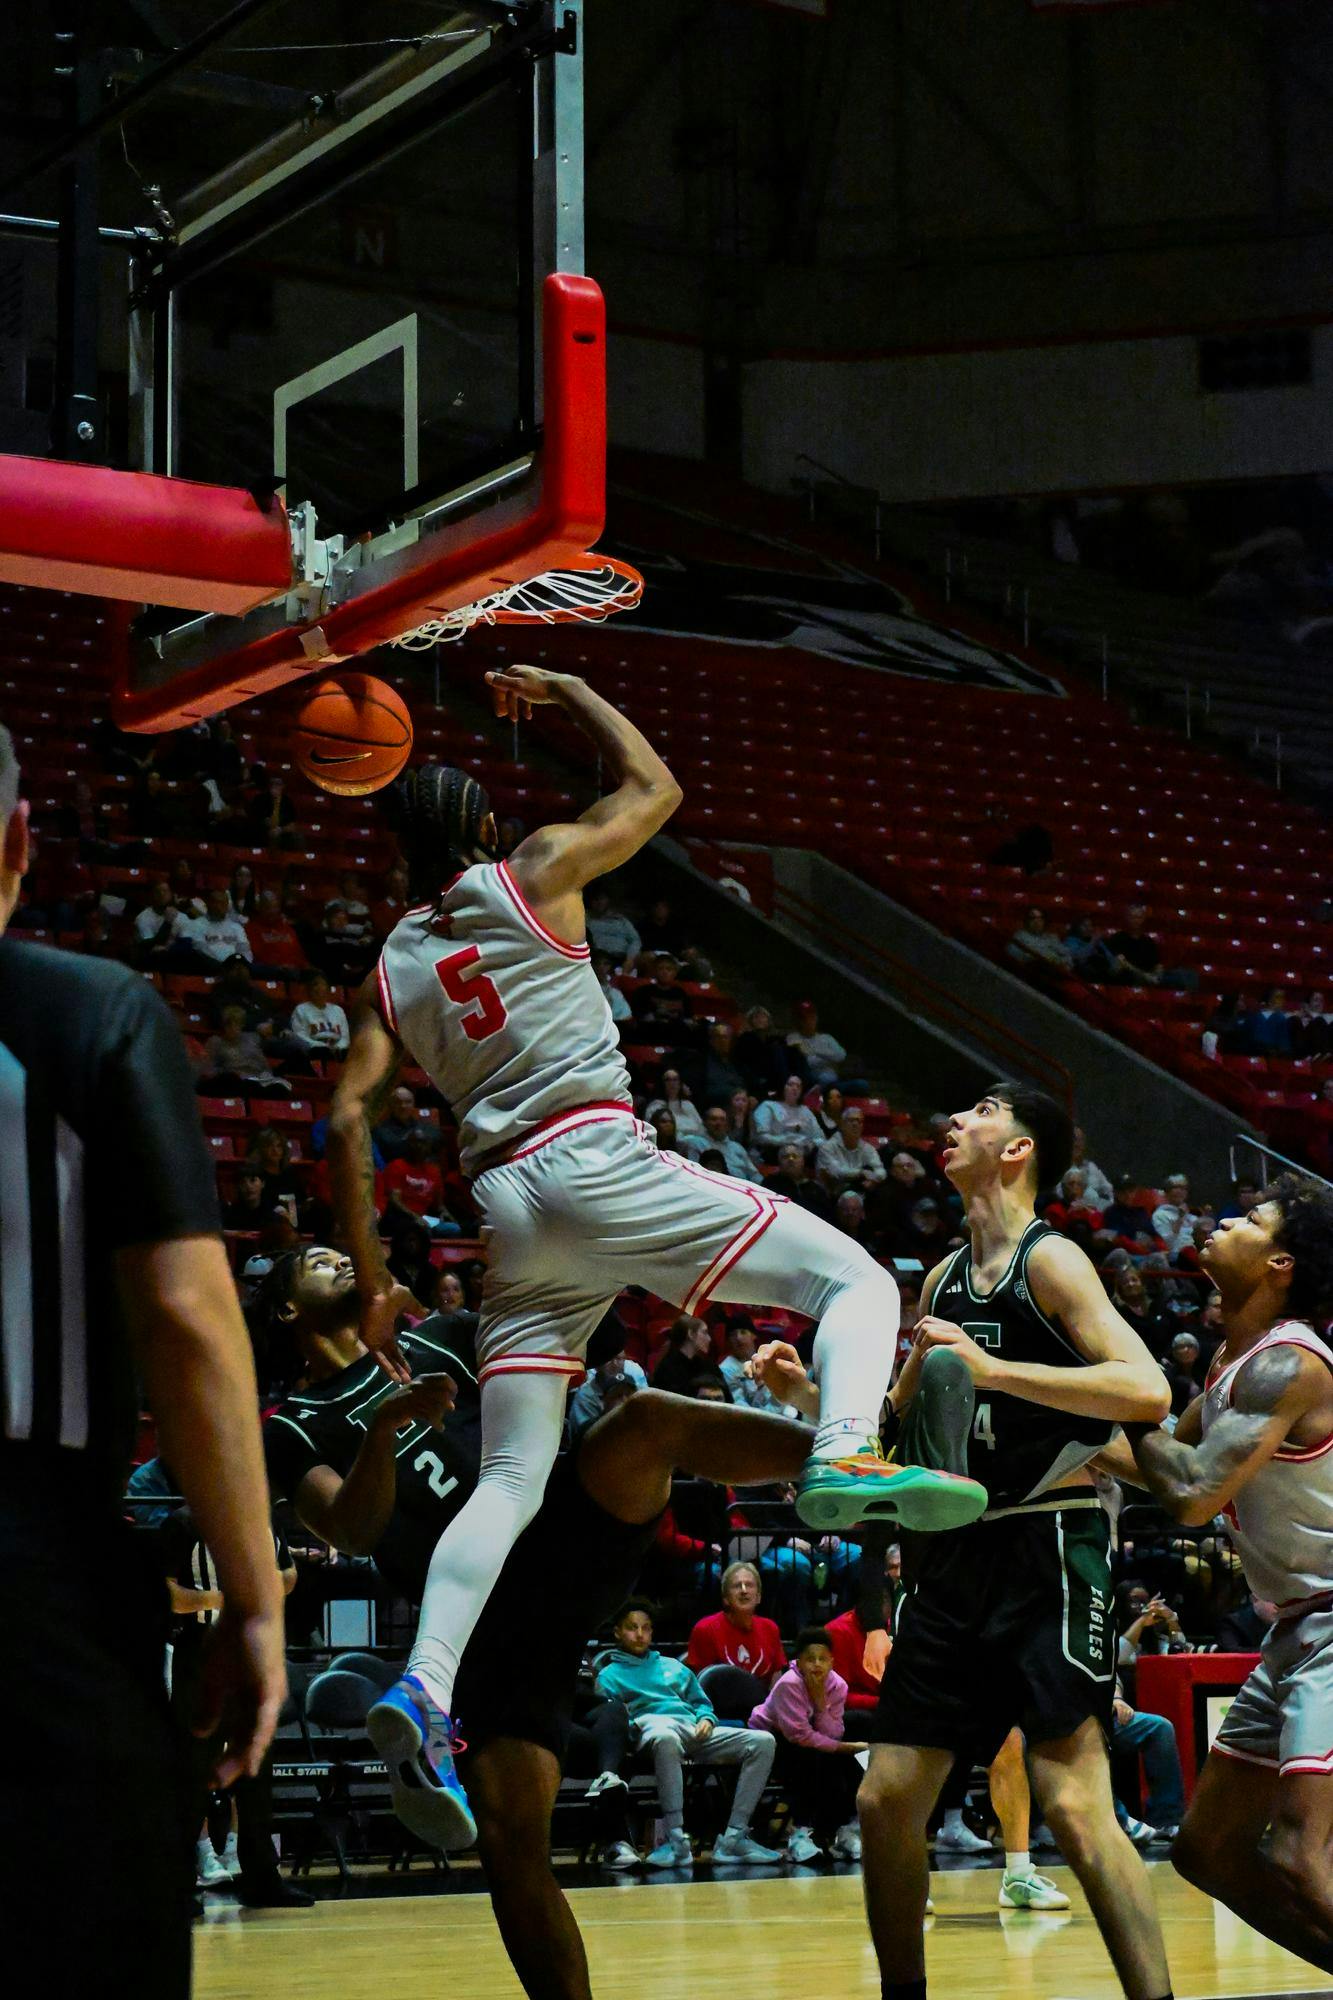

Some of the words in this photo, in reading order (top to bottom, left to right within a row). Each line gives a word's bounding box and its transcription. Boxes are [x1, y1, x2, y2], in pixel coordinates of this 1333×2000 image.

[433, 943, 509, 1043] 5
[973, 1403, 996, 1451] 4
[414, 1450, 460, 1500] 2
[1089, 1585, 1105, 1661] EAGLES
[296, 1767, 329, 1776] STATE
